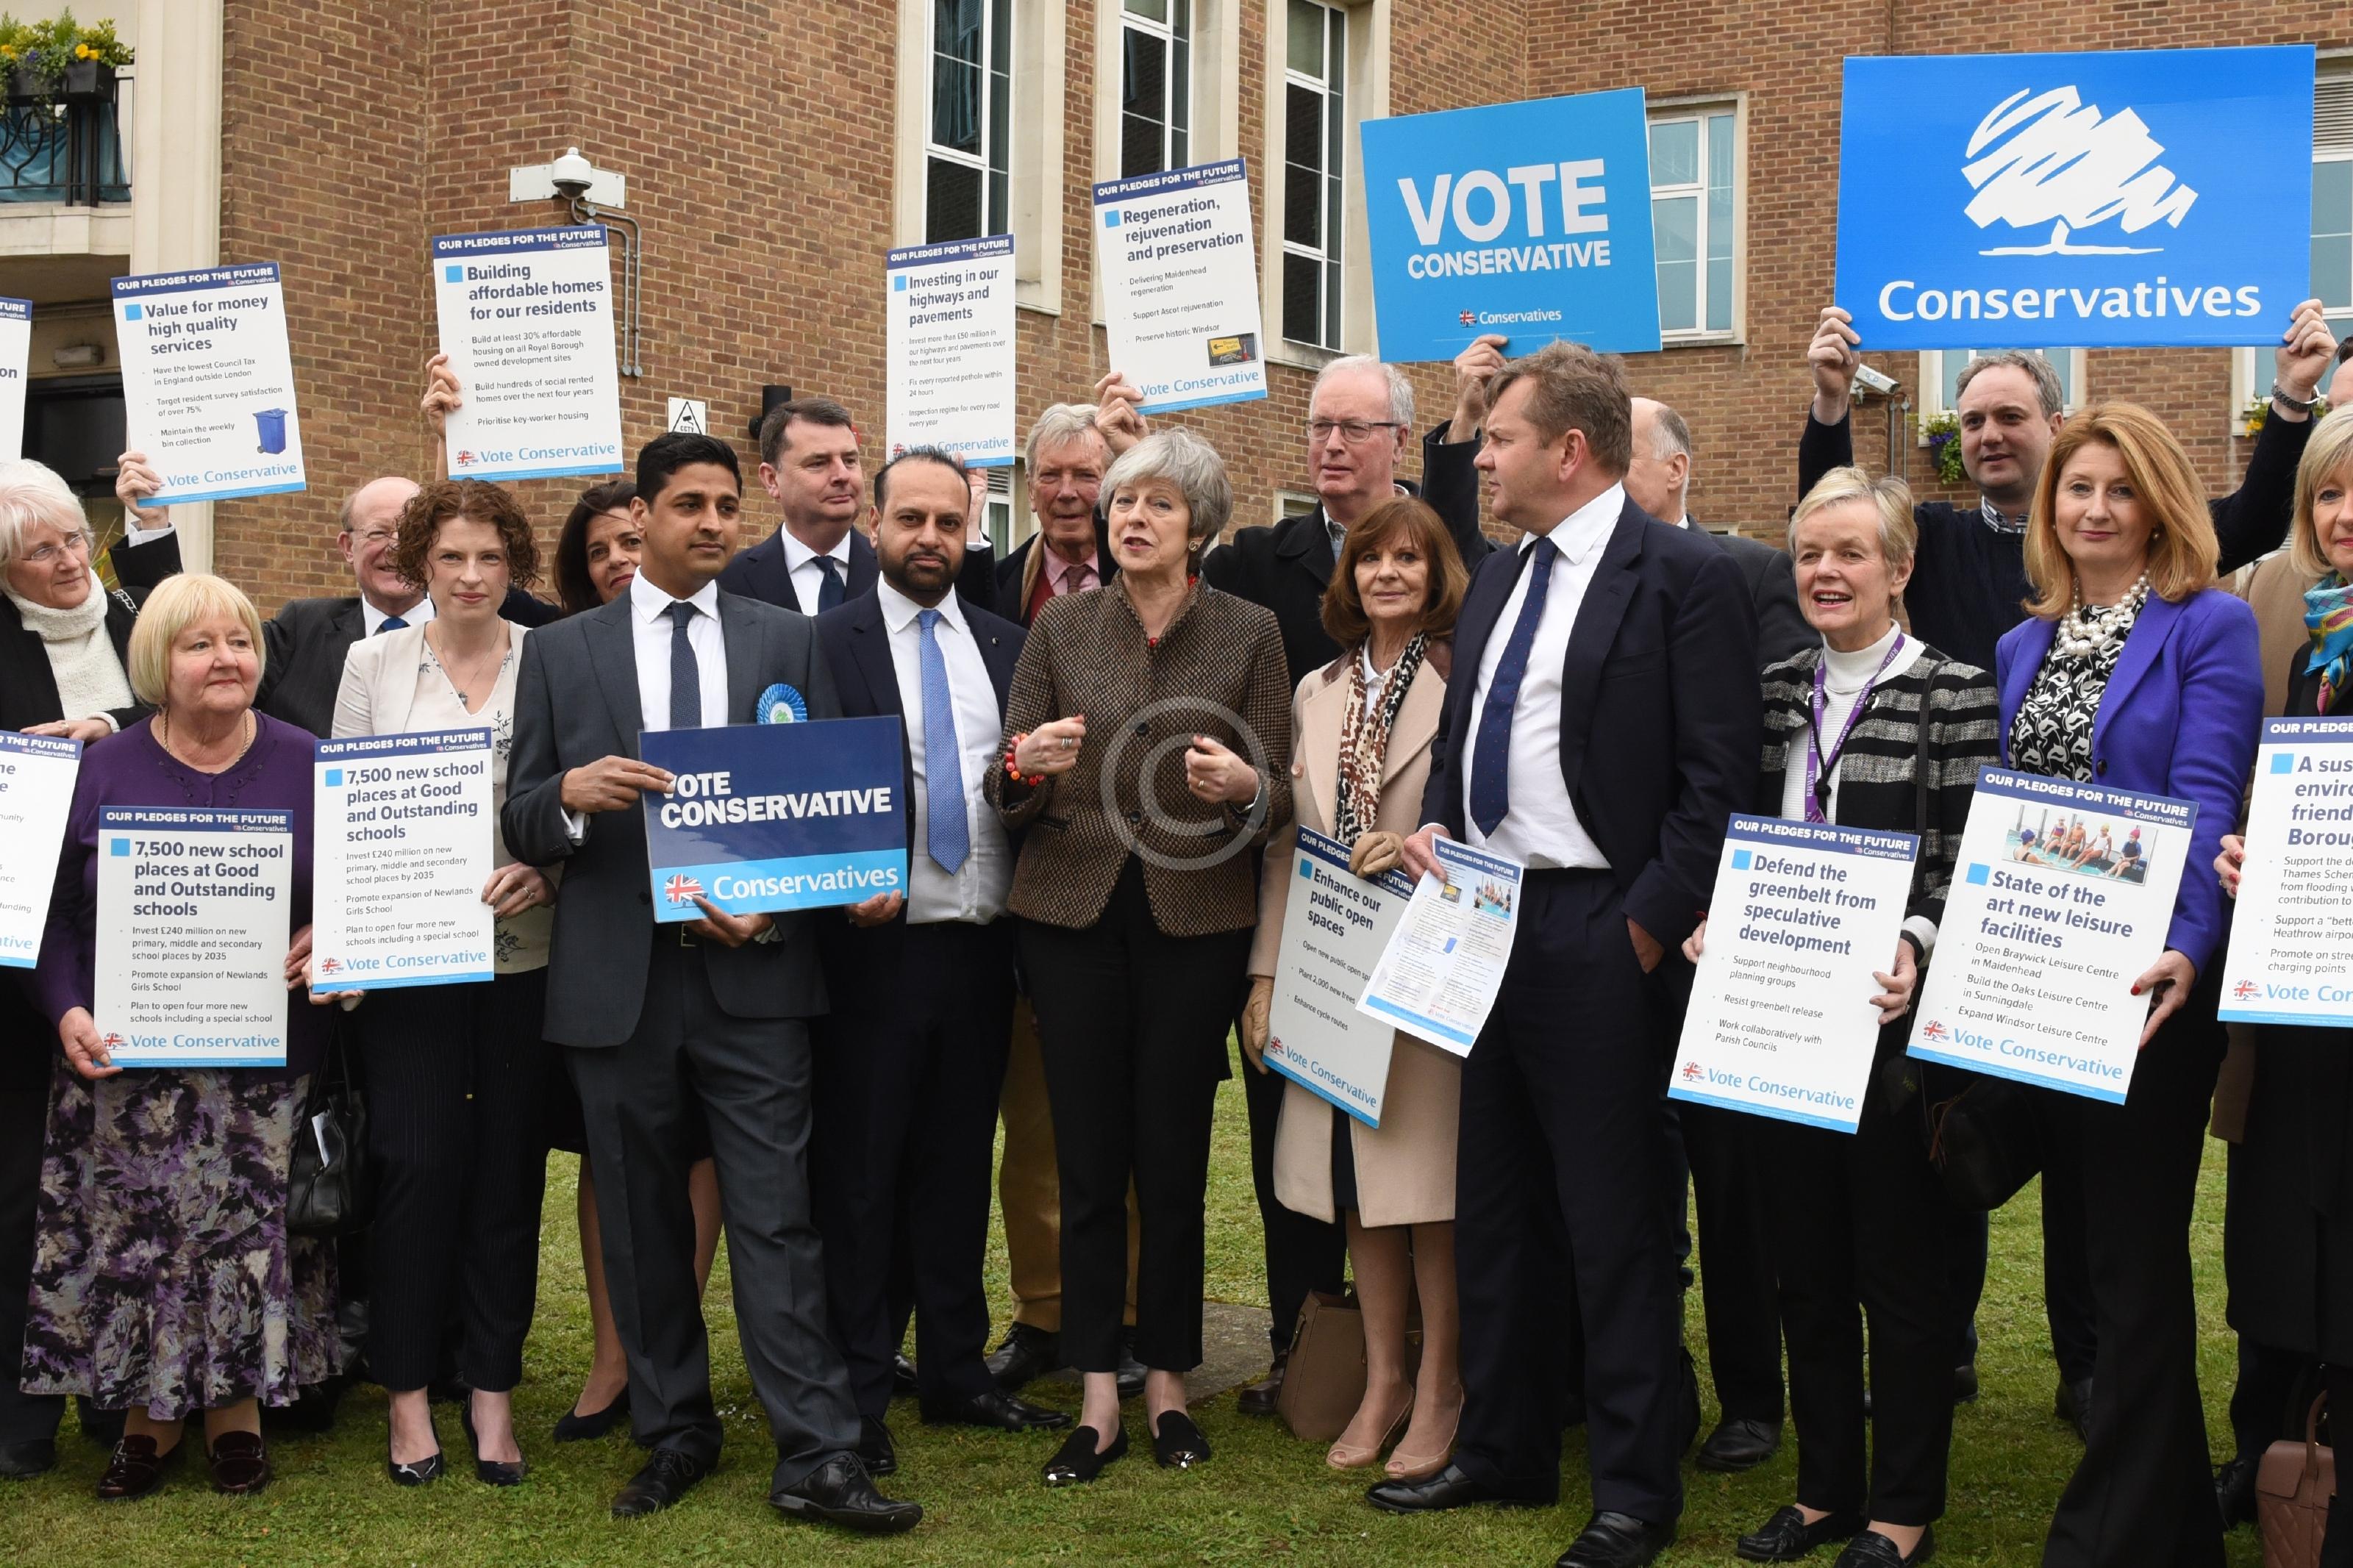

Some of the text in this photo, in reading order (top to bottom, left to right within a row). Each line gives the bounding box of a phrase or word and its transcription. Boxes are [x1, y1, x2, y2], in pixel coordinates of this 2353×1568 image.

[1123, 198, 1220, 225] Regeneration,
[1397, 158, 1609, 246] VOTE
[1126, 218, 1212, 245] rejuvenation
[1127, 232, 1243, 262] and preservation
[1407, 240, 1611, 279] CONSERVATIVE
[467, 263, 531, 281] Building
[910, 269, 999, 290] Investing in our
[1129, 265, 1207, 285] Delivering Maidenhead
[468, 280, 604, 301] affordable homes
[910, 285, 989, 309] highways and
[1130, 284, 1174, 297] regeneration
[1879, 277, 2261, 321] Conservatives
[145, 296, 268, 318] Value for money
[470, 299, 596, 321] for our residents
[909, 307, 973, 329] pavements
[1132, 299, 1224, 320] Support Ascot rejuvenation
[1479, 309, 1562, 325] Conservatives
[148, 315, 238, 338] high quality
[1135, 324, 1220, 343] Preserve historic Windsor
[151, 337, 213, 355] services
[1140, 370, 1259, 397] Vote Conservative
[160, 428, 193, 437] Maintain
[208, 422, 235, 432] weekly
[477, 411, 589, 426] Prioritise key-worker housing
[480, 444, 615, 462] Vote Conservative
[938, 437, 1010, 453] Conservative
[167, 463, 297, 487] Vote Conservative
[1813, 684, 1822, 709] RBWM
[7, 736, 76, 752] THE FUTURE
[346, 760, 484, 786] 7,500 new school
[2297, 756, 2313, 773] A
[1806, 770, 1815, 797] RBWM
[1985, 773, 2189, 817] OUR PLEDGES FOR THE FUTURE
[660, 787, 892, 828] CONSERVATIVE
[2291, 803, 2353, 820] friend
[135, 841, 283, 858] 7,500 new school
[2288, 828, 2353, 850] Borou
[135, 861, 259, 879] places at Good
[1754, 854, 1847, 882] Defend the
[134, 881, 275, 901] and Outstanding
[713, 865, 899, 901] Conservatives
[1313, 867, 1382, 912] Enhance our
[1992, 870, 2106, 907] State of the
[1749, 881, 1877, 910] greenbelt from
[2278, 895, 2352, 906] contribution to
[133, 901, 198, 916] schools
[1310, 890, 1374, 931] public open
[1743, 904, 1841, 929] speculative
[1986, 898, 2133, 937] art new leisure
[1307, 909, 1345, 937] spaces
[1980, 917, 2063, 948] facilities
[1739, 923, 1852, 956] development
[346, 950, 487, 970] Vote Conservative
[1732, 955, 1832, 979] Support neighbourhood
[1971, 958, 2042, 978] in Maidenhead
[1975, 942, 2119, 979] Open Braywick Leisure Centre
[2268, 962, 2346, 975] charging points
[131, 982, 182, 992] Girls School
[132, 970, 268, 980] Promote expansion of Newlands
[1299, 967, 1355, 1004] Plant 2,000 new trees
[1729, 970, 1796, 989] planning groups
[1963, 987, 2033, 1011] in Sunningdale
[1966, 973, 2108, 1012] Build the Oaks Leisure Centre
[1724, 994, 1824, 1019] Resist greenbelt release
[1719, 1018, 1822, 1045] Work collaboratively with
[1958, 1005, 2108, 1046] Expand Windsor Leisure Centre
[130, 1034, 280, 1048] Vote Conservative
[1715, 1032, 1777, 1052] Parish Councils
[1954, 1028, 2123, 1079] Vote Conservative
[1286, 1045, 1377, 1108] Vote Conservative
[1708, 1067, 1854, 1110] Vote Conservative
